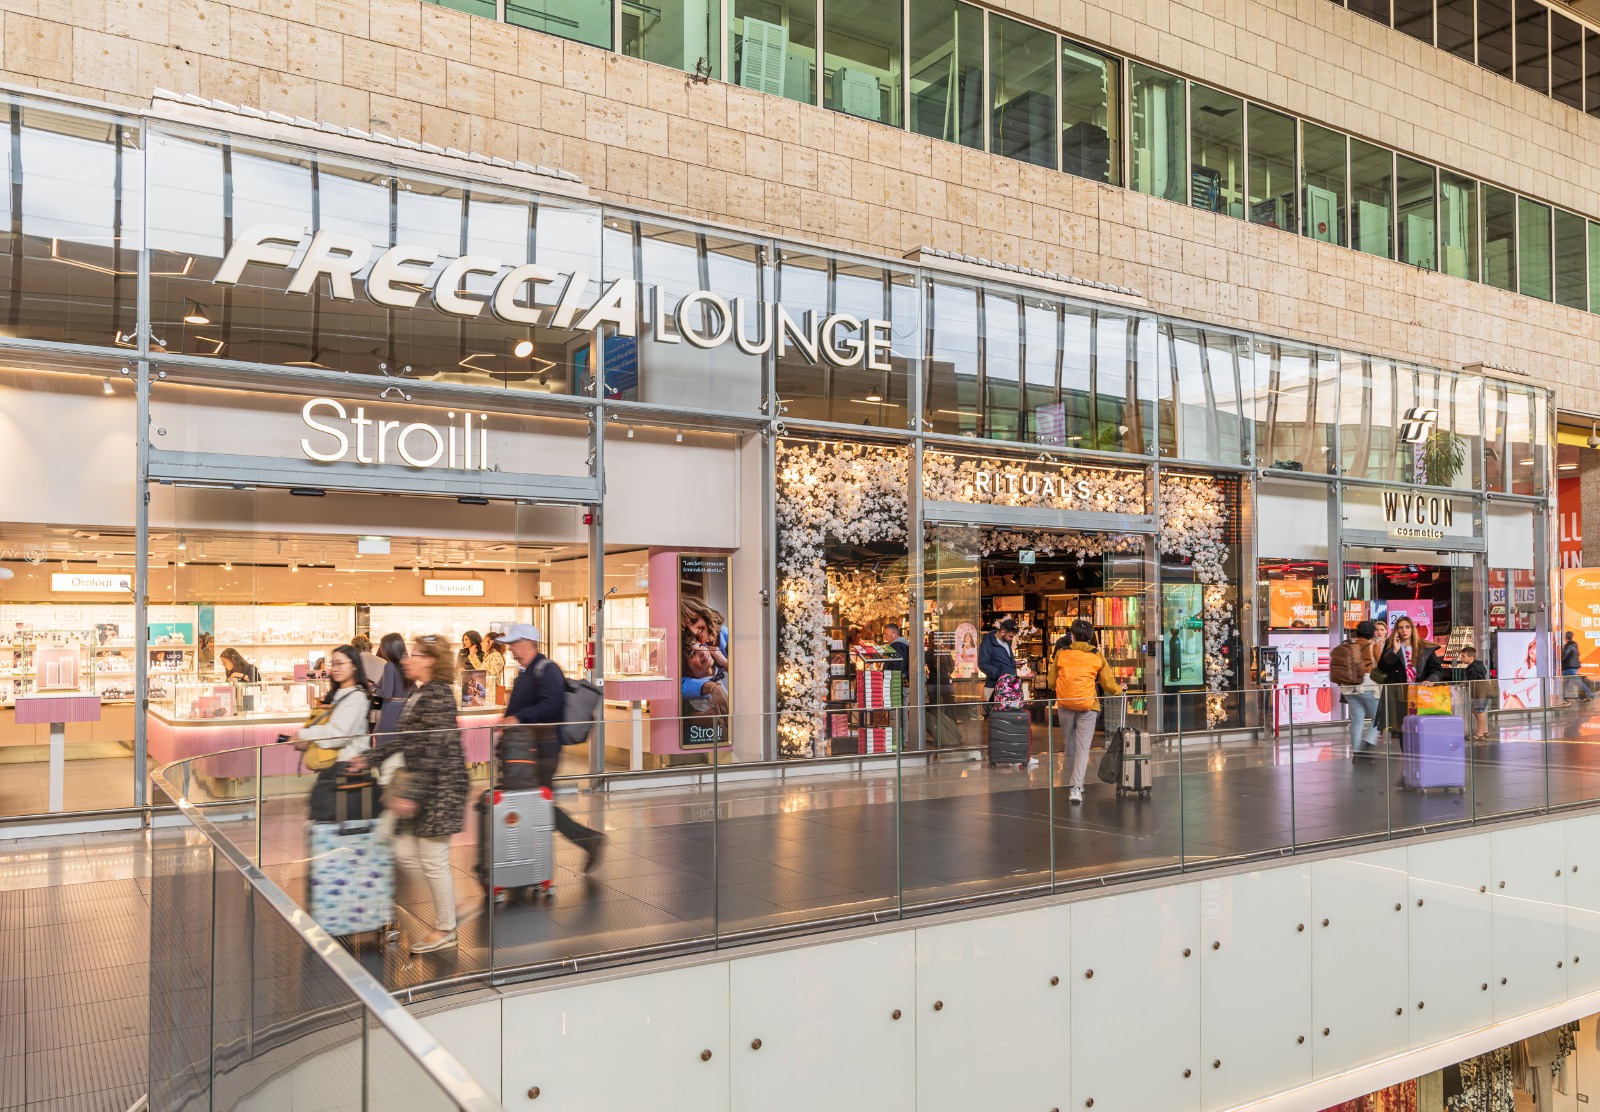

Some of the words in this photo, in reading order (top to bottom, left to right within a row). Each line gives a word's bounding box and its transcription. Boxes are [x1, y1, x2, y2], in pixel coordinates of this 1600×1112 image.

[301, 397, 488, 470] Stroili
[1382, 491, 1453, 527] WYCON
[1397, 527, 1444, 539] cosmetics
[71, 578, 112, 588] Orologi
[435, 583, 474, 592] Diamanti
[690, 725, 723, 739] Stroli
